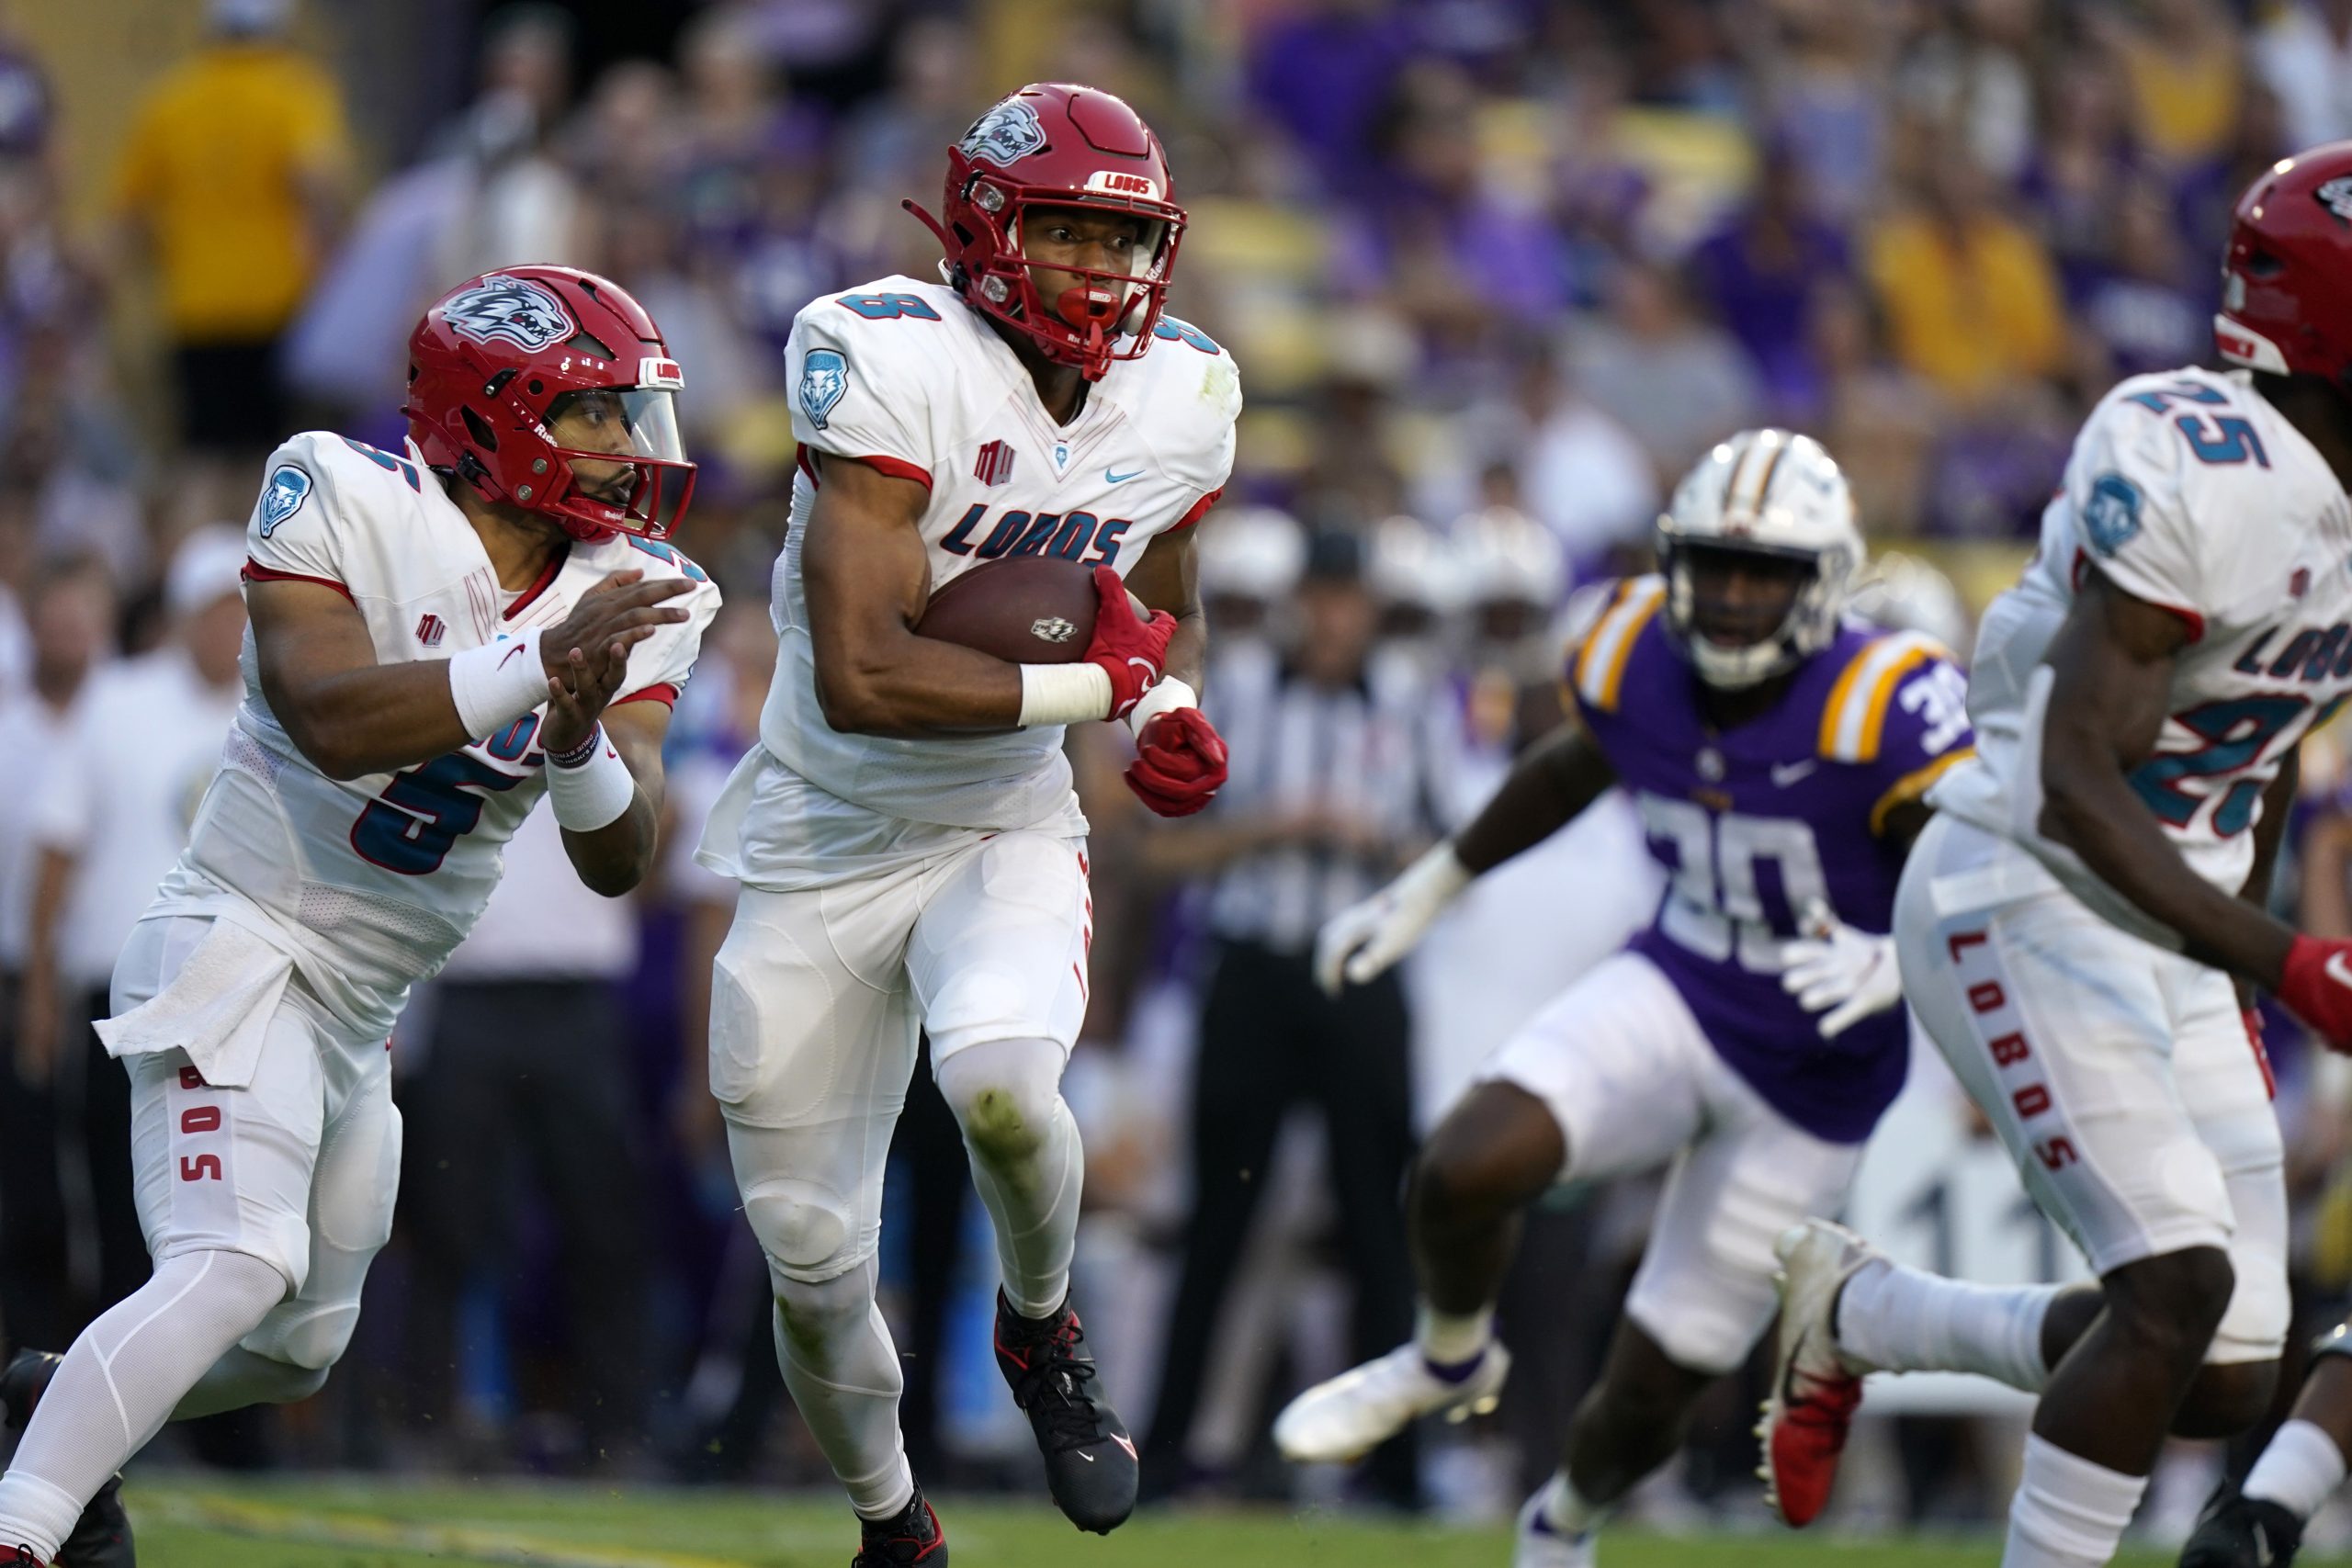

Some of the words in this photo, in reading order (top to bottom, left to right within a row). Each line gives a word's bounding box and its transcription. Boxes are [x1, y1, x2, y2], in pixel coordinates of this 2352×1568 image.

[1105, 175, 1149, 194] LOBOS
[834, 293, 942, 321] 8
[2120, 379, 2273, 470] 25
[939, 503, 1134, 567] LOBOS
[350, 750, 528, 875] 5
[1639, 789, 1833, 975] 30
[1947, 929, 2078, 1171] LOBOS
